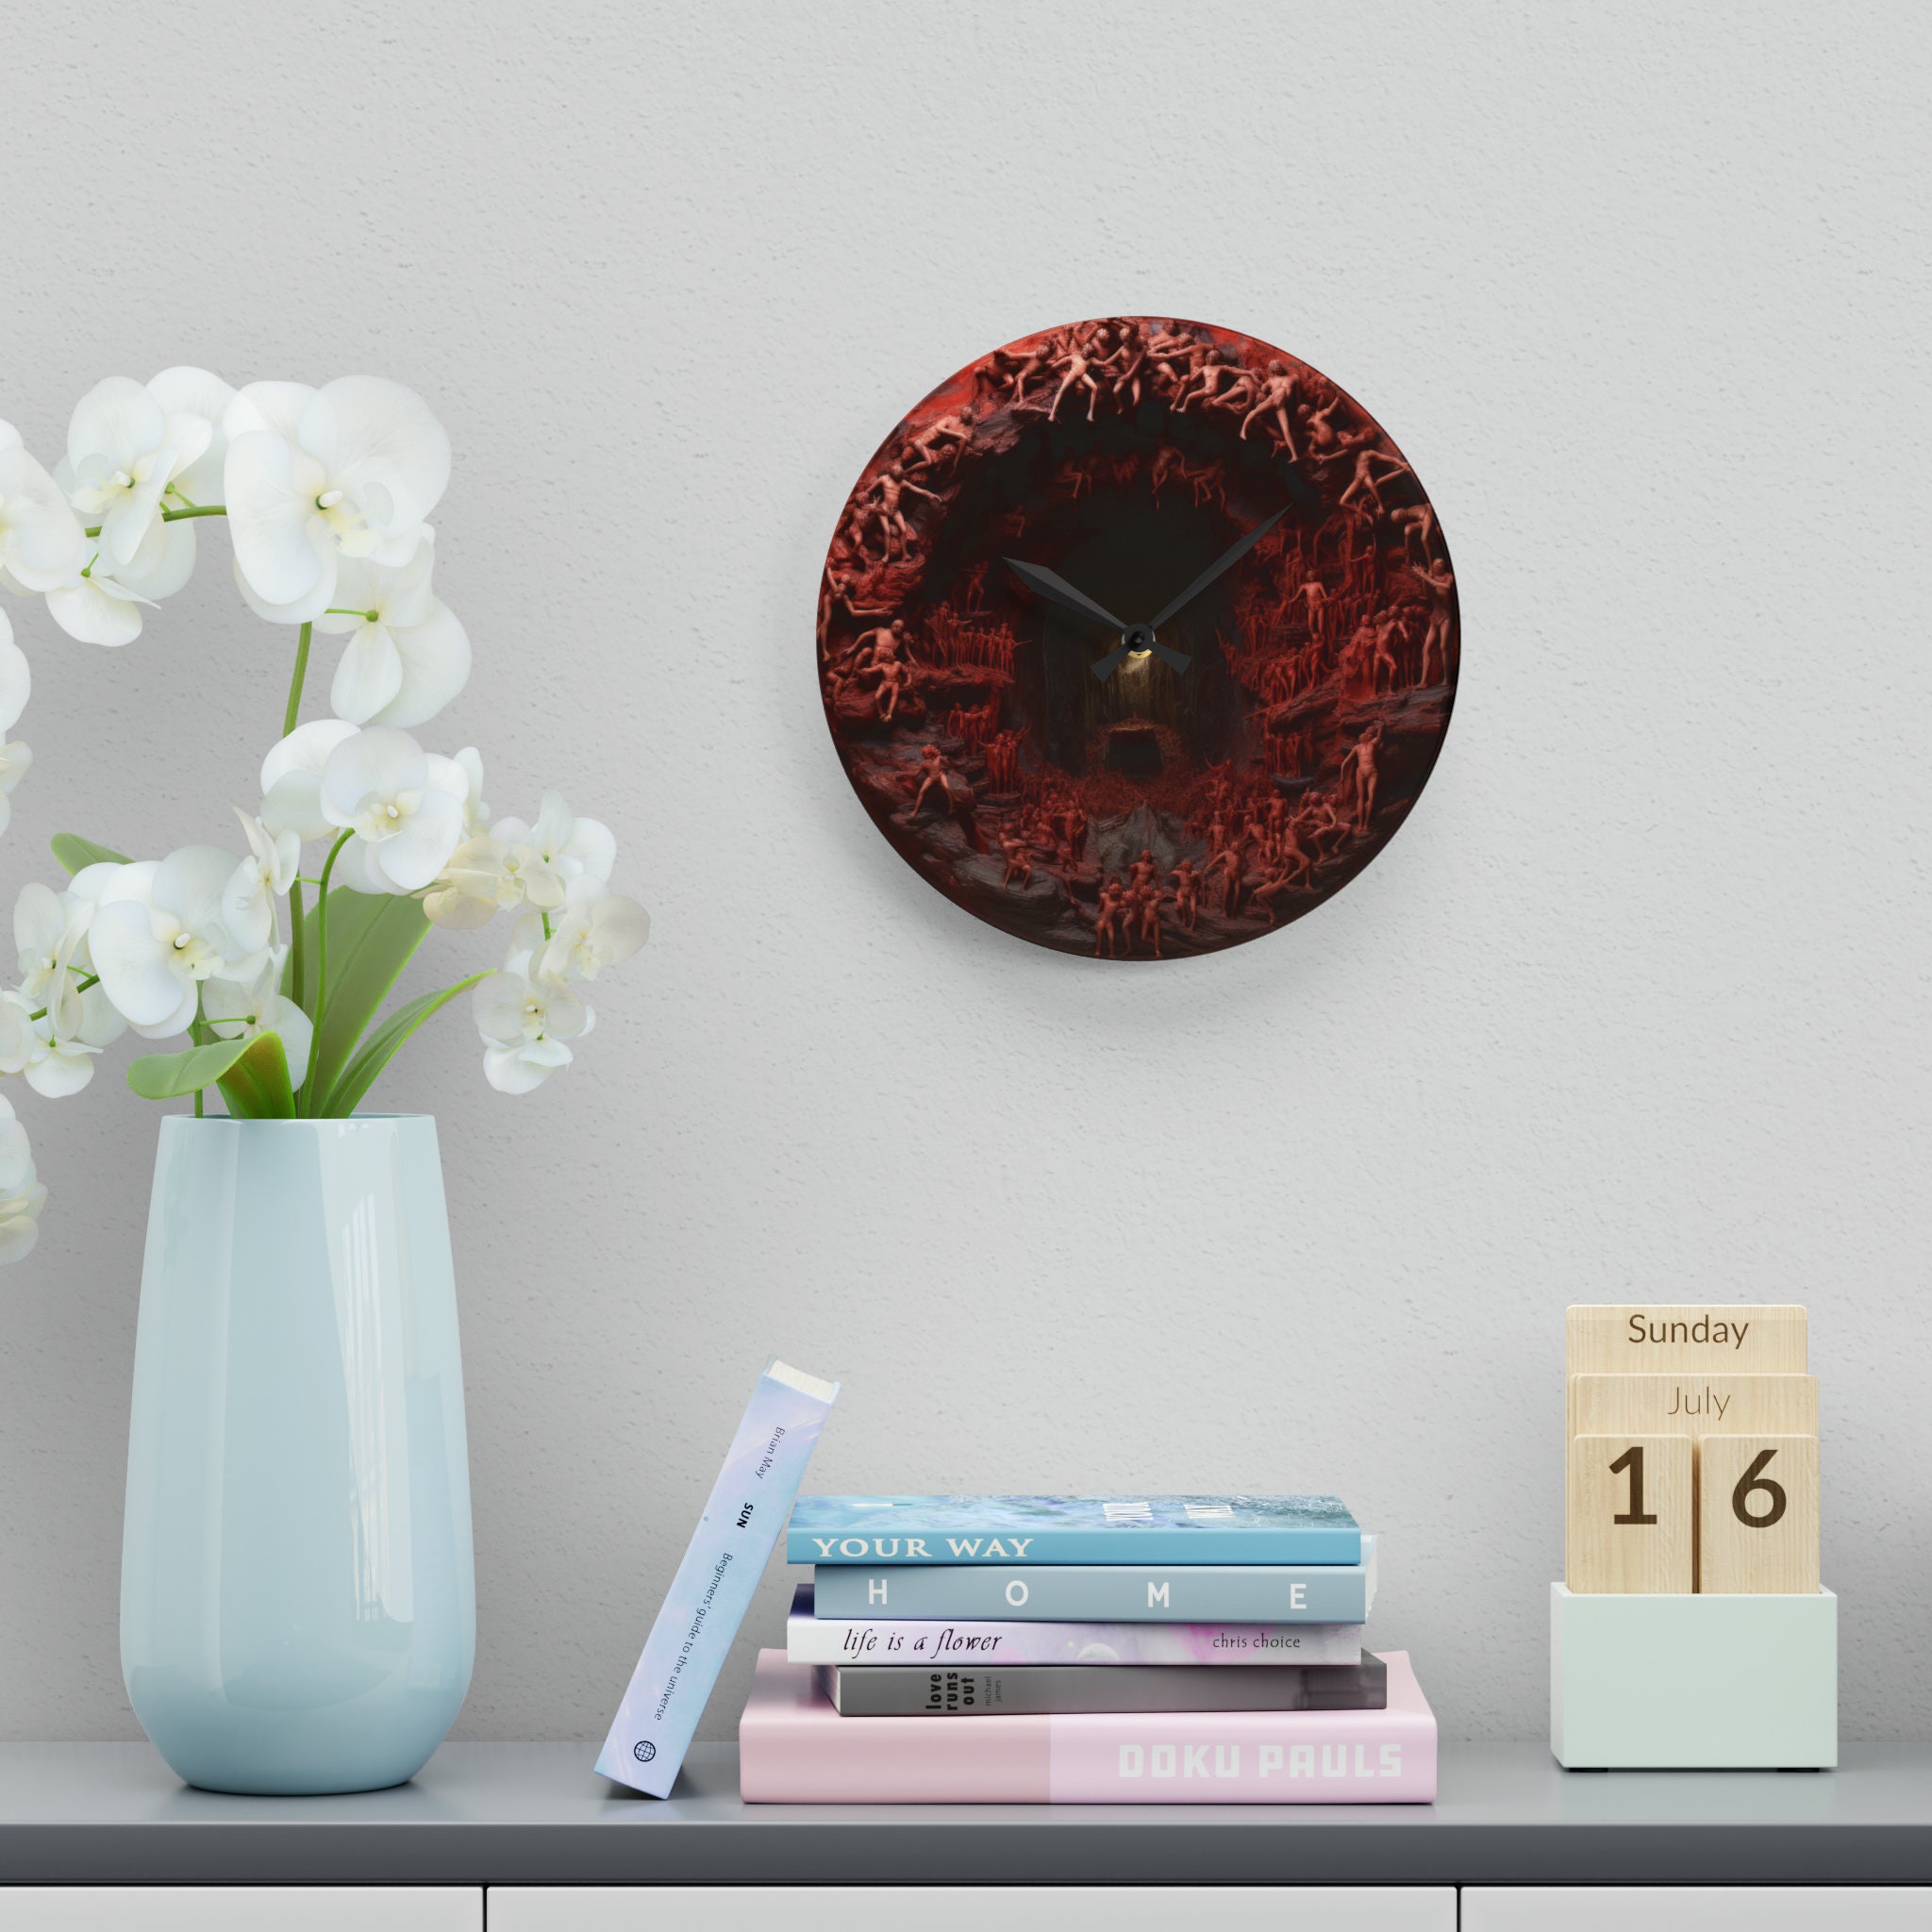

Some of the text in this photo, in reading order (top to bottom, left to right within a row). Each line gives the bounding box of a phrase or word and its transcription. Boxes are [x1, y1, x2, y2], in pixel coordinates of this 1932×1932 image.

[1628, 1314, 1749, 1349] Sunday
[1667, 1386, 1731, 1421] July
[756, 1426, 785, 1479] Brian May
[736, 1503, 754, 1528] SUN
[812, 1538, 1034, 1557] YOUR WAY
[688, 1608, 707, 1640] guide
[682, 1641, 693, 1653] to
[843, 1628, 1003, 1659] life is a flower
[1212, 1632, 1301, 1649] chris choice
[673, 1656, 688, 1674] the
[654, 1676, 678, 1721] universe
[925, 1674, 942, 1709] love
[947, 1673, 958, 1710] runs
[960, 1677, 974, 1706] out
[1119, 1744, 1402, 1778] DOKU PAULS
